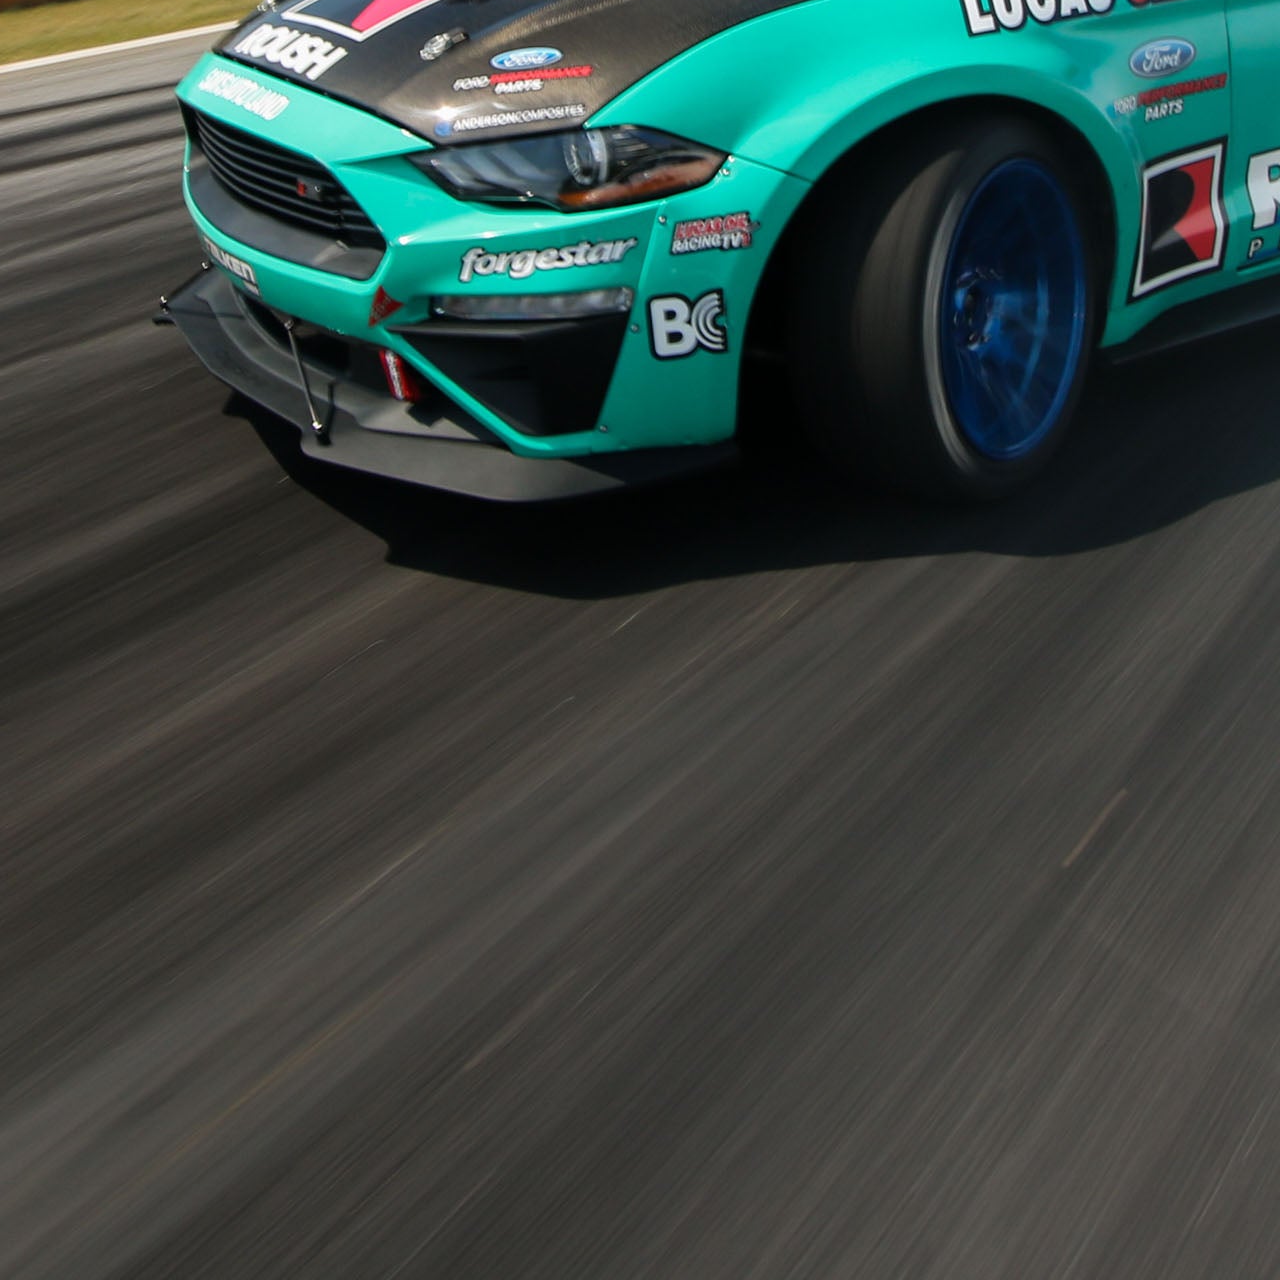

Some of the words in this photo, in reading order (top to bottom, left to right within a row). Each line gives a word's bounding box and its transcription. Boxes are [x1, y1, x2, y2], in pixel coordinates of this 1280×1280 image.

[234, 23, 348, 81] ROUSH
[1144, 99, 1184, 122] PARTS
[459, 238, 637, 282] forgestar
